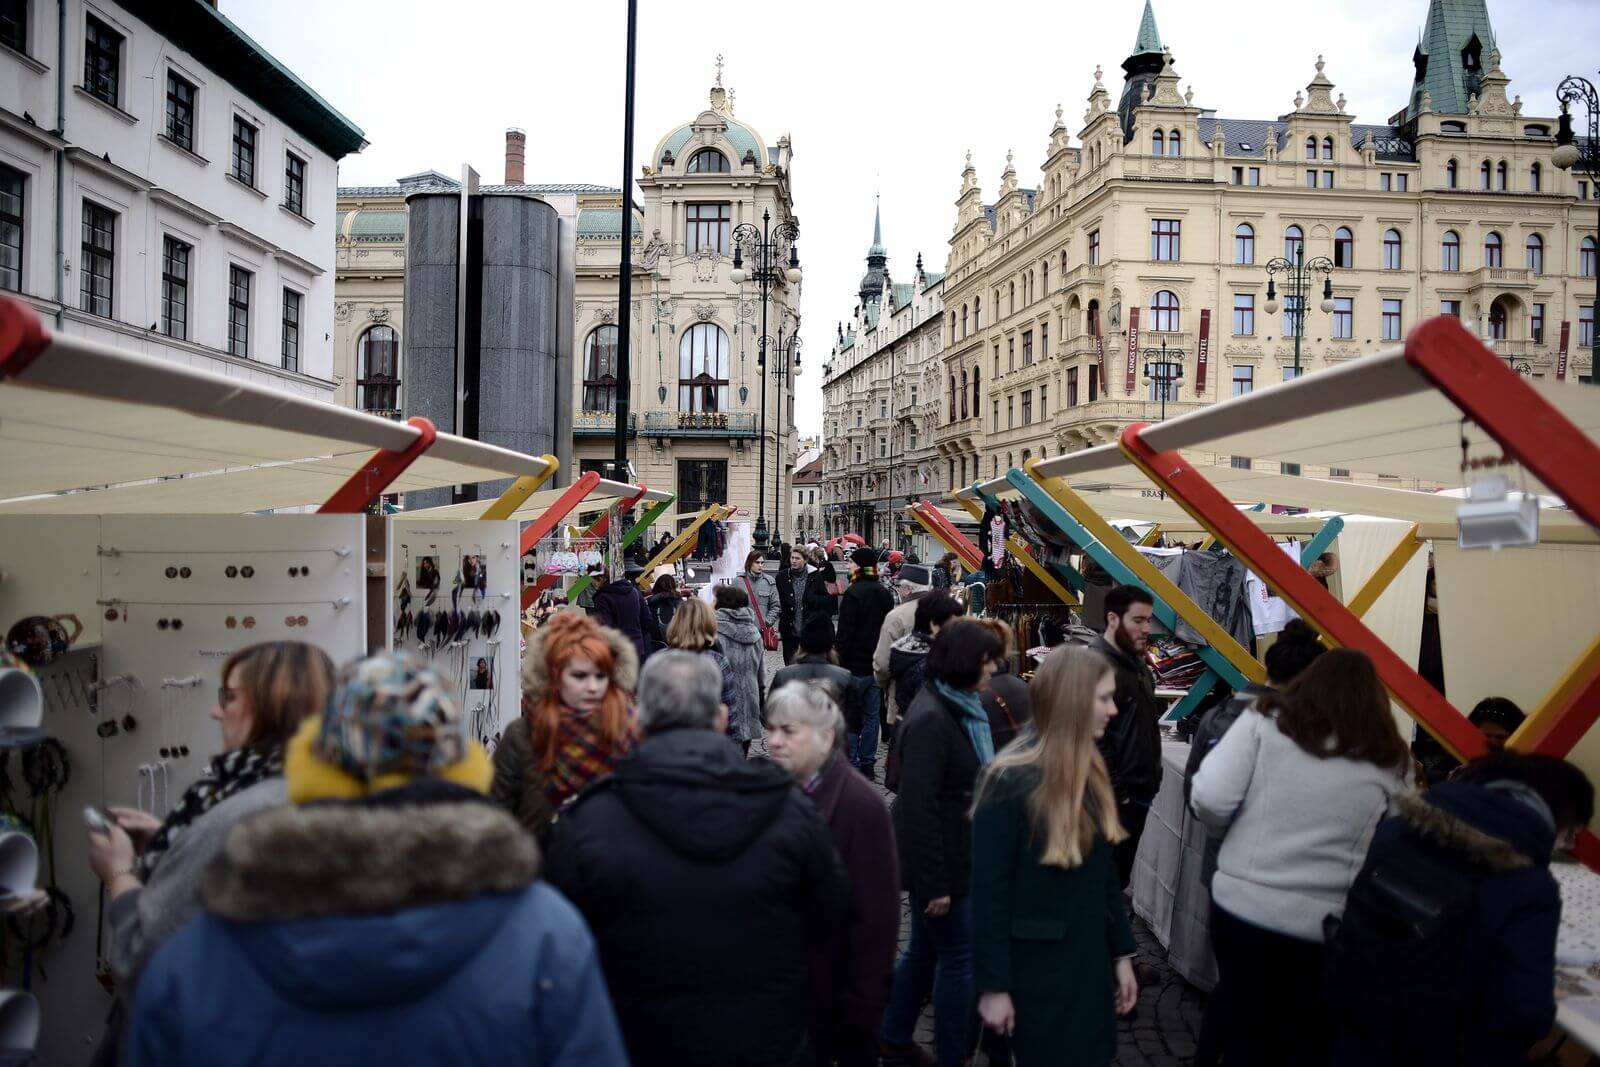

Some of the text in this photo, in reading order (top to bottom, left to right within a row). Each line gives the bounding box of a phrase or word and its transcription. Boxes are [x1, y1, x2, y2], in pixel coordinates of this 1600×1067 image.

[1128, 351, 1136, 374] KINGS
[1199, 337, 1208, 363] HOTEL
[1558, 349, 1567, 375] HOTEL
